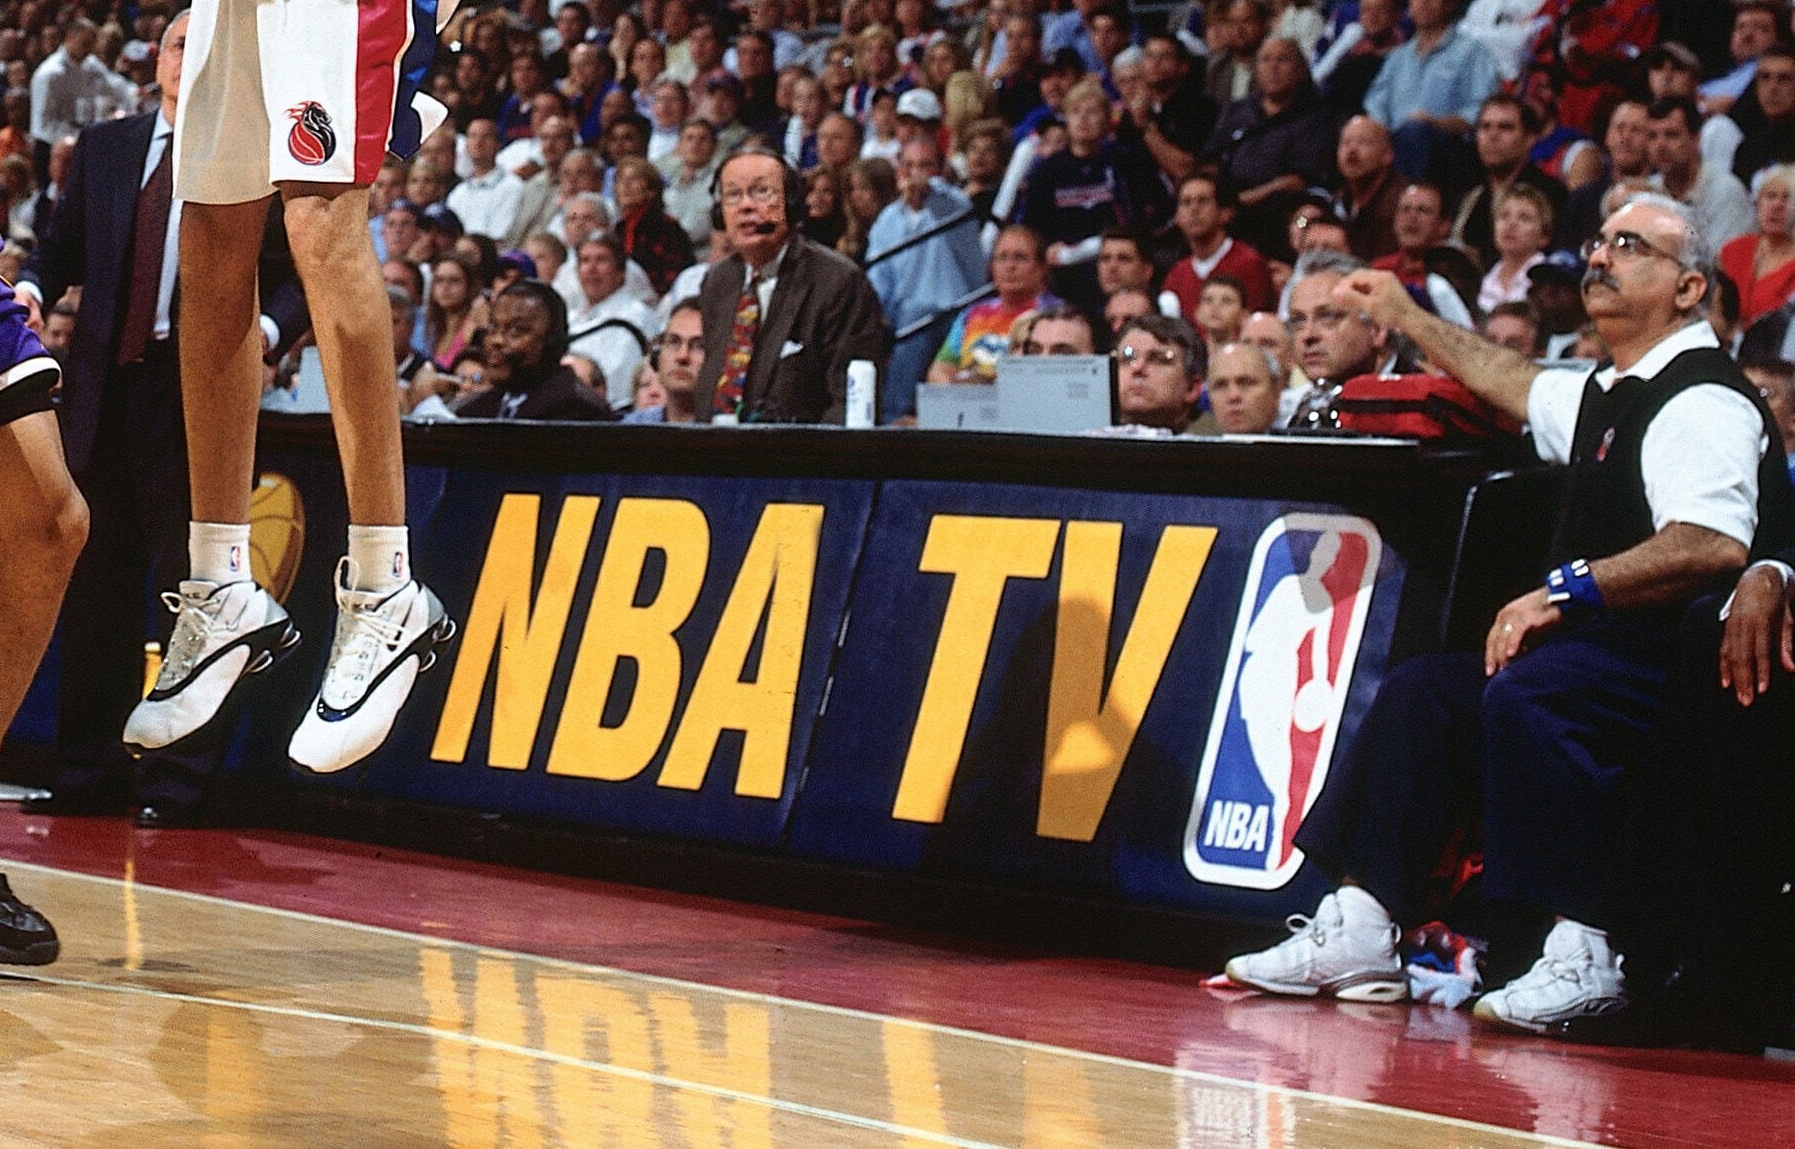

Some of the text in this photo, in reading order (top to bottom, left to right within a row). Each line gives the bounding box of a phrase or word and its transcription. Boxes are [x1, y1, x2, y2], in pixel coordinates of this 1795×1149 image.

[430, 492, 1220, 842] NBA TV
[1205, 799, 1271, 854] NBA
